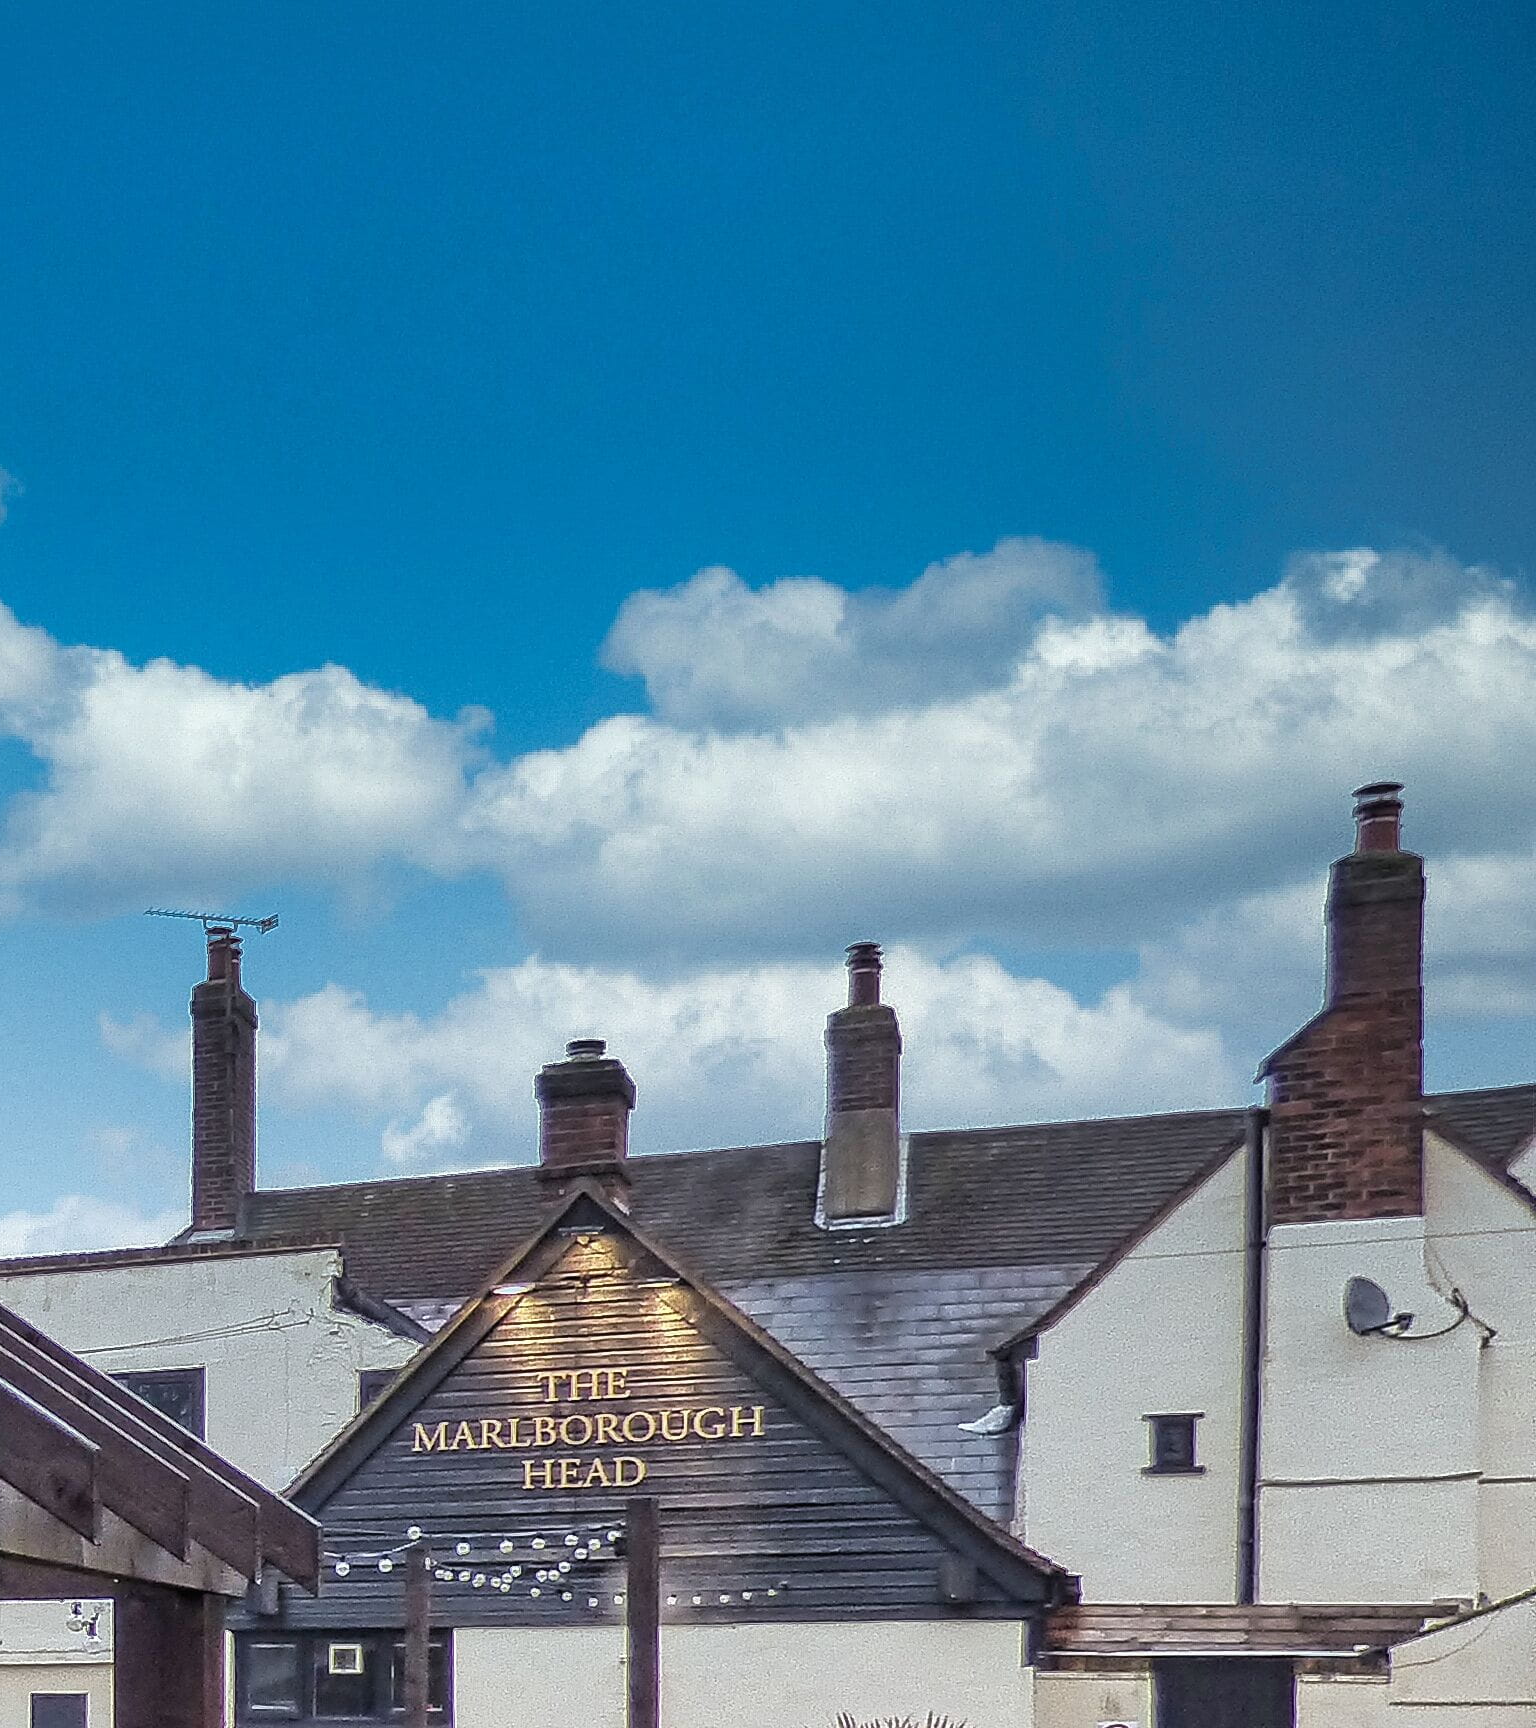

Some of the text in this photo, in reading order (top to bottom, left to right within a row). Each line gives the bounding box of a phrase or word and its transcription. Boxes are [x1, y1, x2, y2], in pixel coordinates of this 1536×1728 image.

[537, 1368, 631, 1402] THE
[412, 1405, 766, 1454] MARLBOROUGH
[522, 1456, 648, 1490] HEAD
